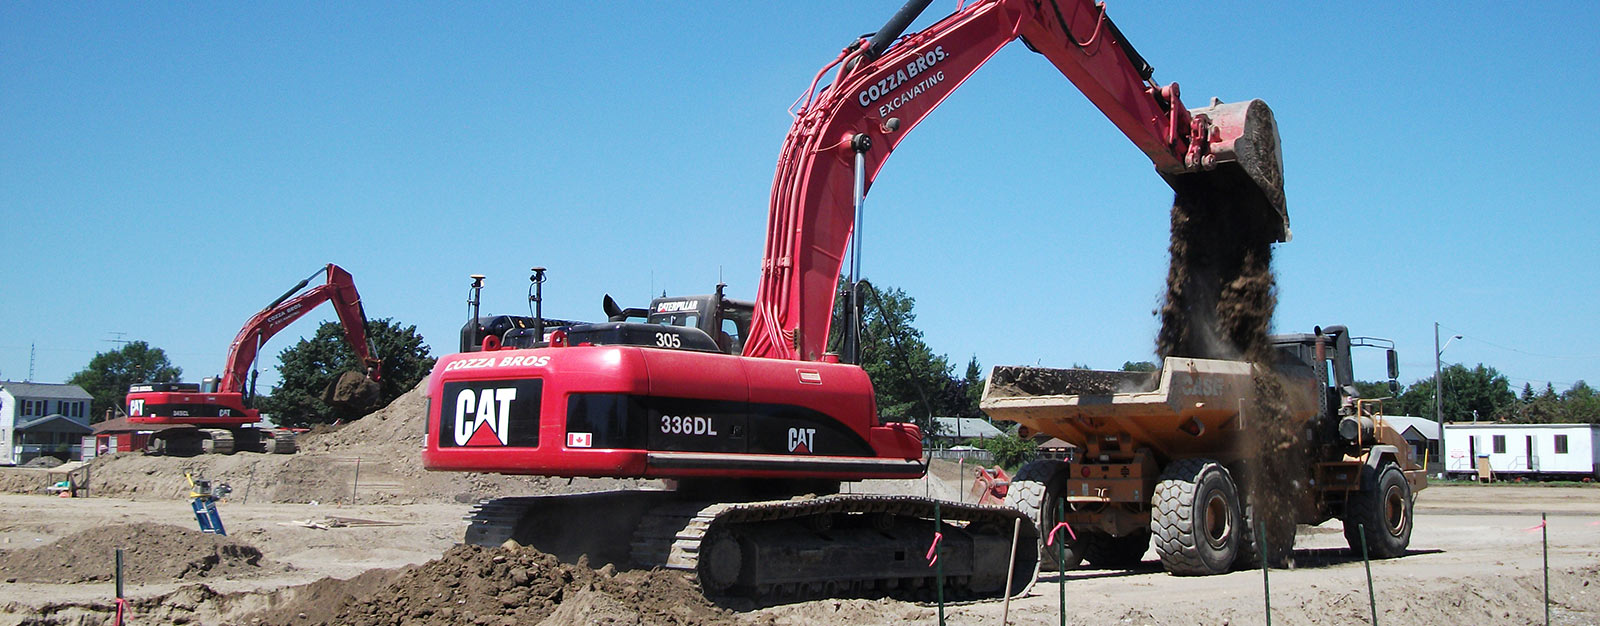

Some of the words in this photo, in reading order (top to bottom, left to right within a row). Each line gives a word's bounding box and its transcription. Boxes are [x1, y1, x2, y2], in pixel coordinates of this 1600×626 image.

[859, 69, 908, 107] COZZA
[906, 46, 950, 78] BROS.
[879, 71, 945, 117] EXCAVATING
[657, 301, 698, 312] CATERPILLAR
[655, 332, 681, 348] 305
[445, 359, 495, 372] COZZA
[498, 356, 551, 368] BROS
[130, 399, 145, 417] CAT
[219, 408, 231, 417] CAT
[454, 387, 517, 447] CAT
[661, 415, 717, 436] 336DL
[788, 427, 816, 453] CAT
